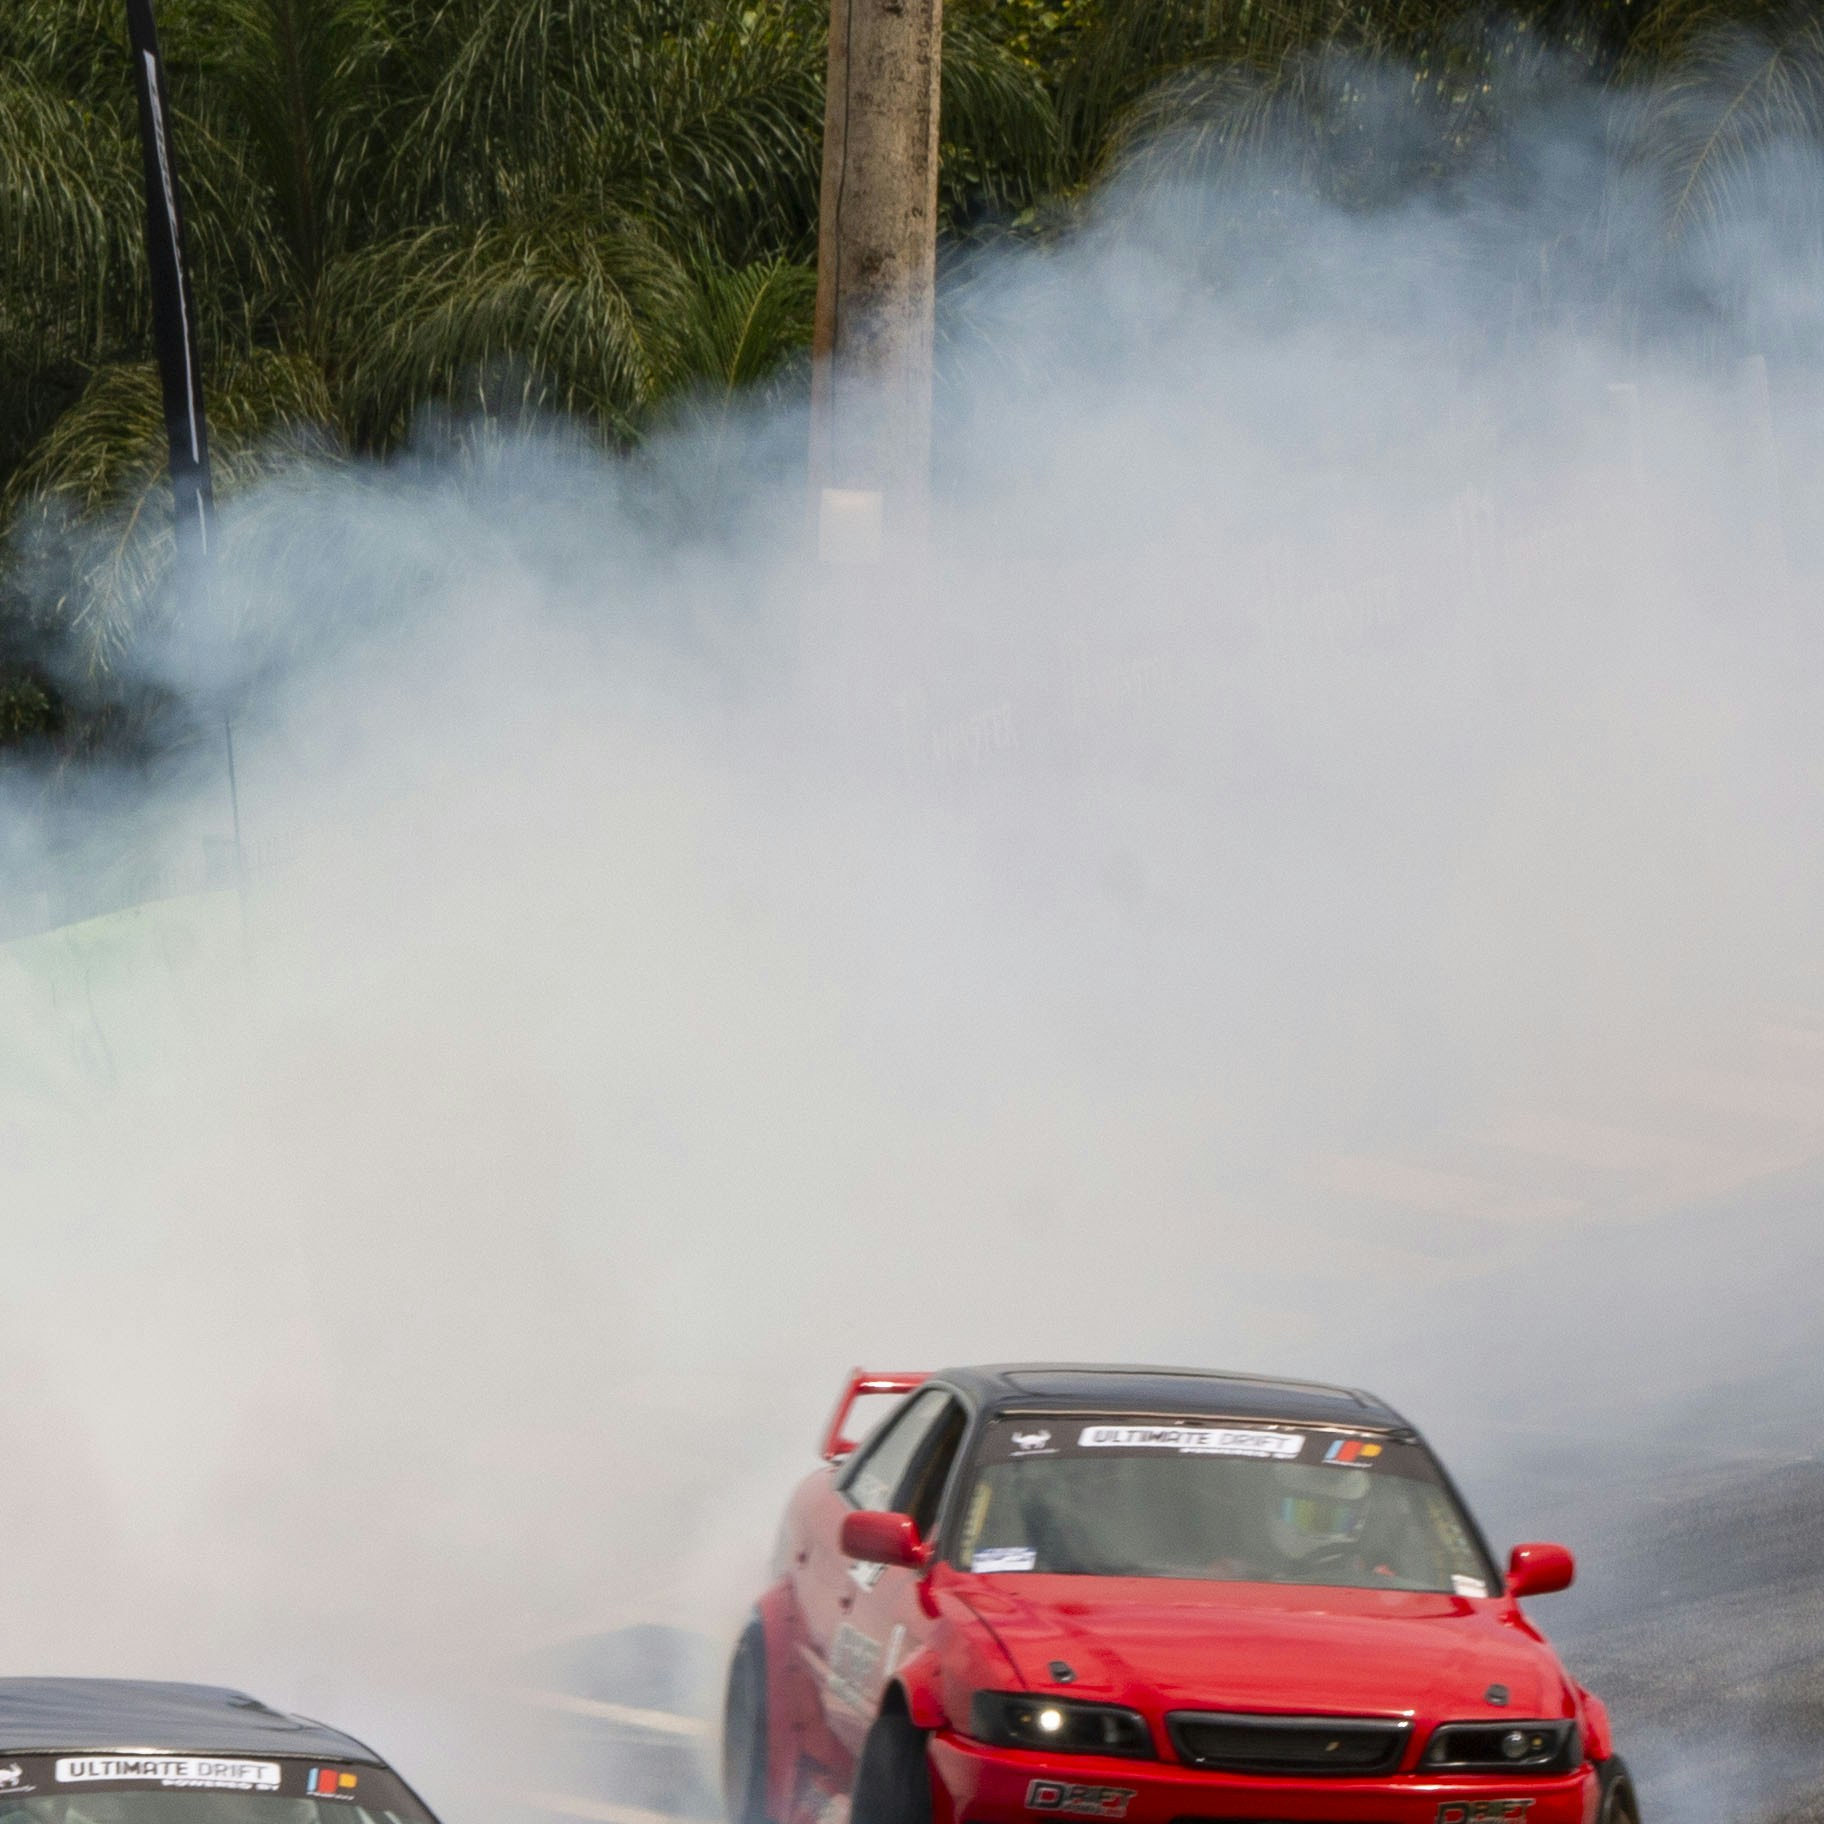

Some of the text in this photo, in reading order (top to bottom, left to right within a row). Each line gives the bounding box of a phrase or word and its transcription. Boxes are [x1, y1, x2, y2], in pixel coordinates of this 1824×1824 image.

[1094, 1429, 1289, 1452] ULTIMATE DRIFT
[69, 1760, 267, 1781] ULTIMATE DRIFT
